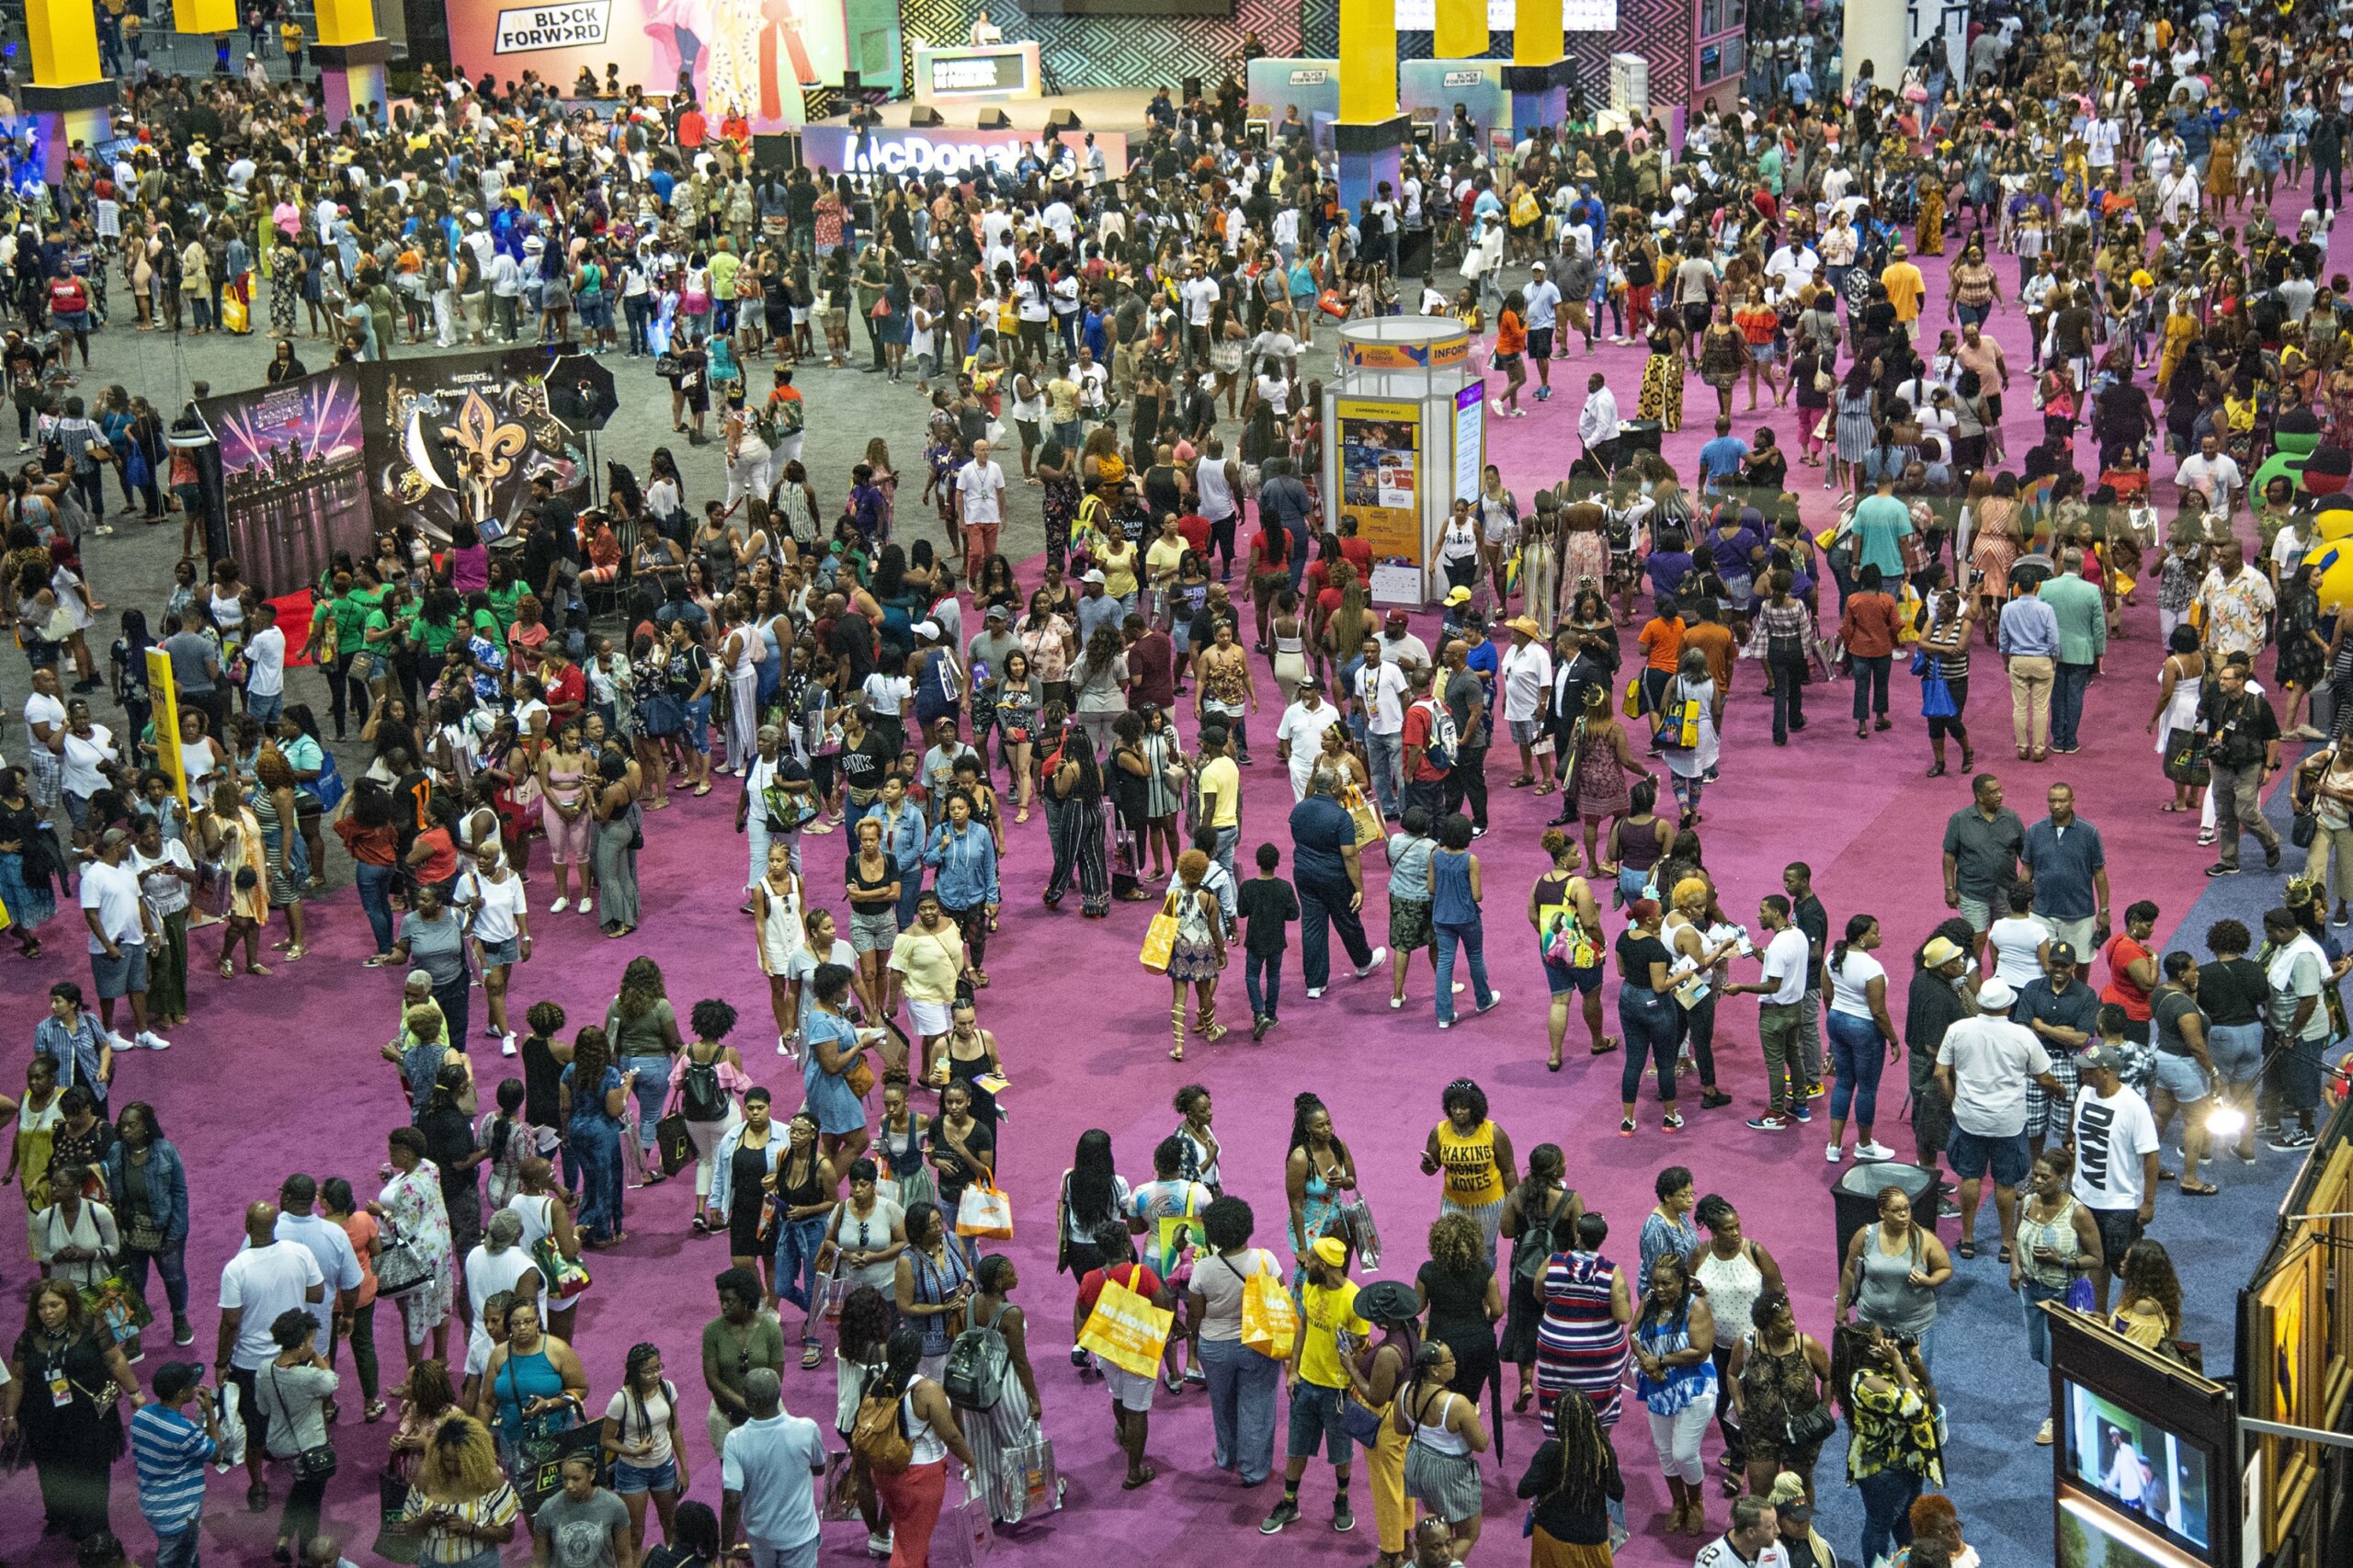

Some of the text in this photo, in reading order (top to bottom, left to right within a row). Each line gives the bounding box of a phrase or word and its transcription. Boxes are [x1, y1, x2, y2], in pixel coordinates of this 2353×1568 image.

[458, 373, 487, 383] ESSENCE
[481, 383, 501, 394] 2018
[842, 753, 875, 775] PINK
[1440, 1145, 1492, 1163] MAKING
[2077, 1101, 2115, 1191] DKNY
[1446, 1162, 1490, 1176] MONEY
[1450, 1173, 1492, 1191] MOVES
[1097, 1302, 1116, 1319] HI
